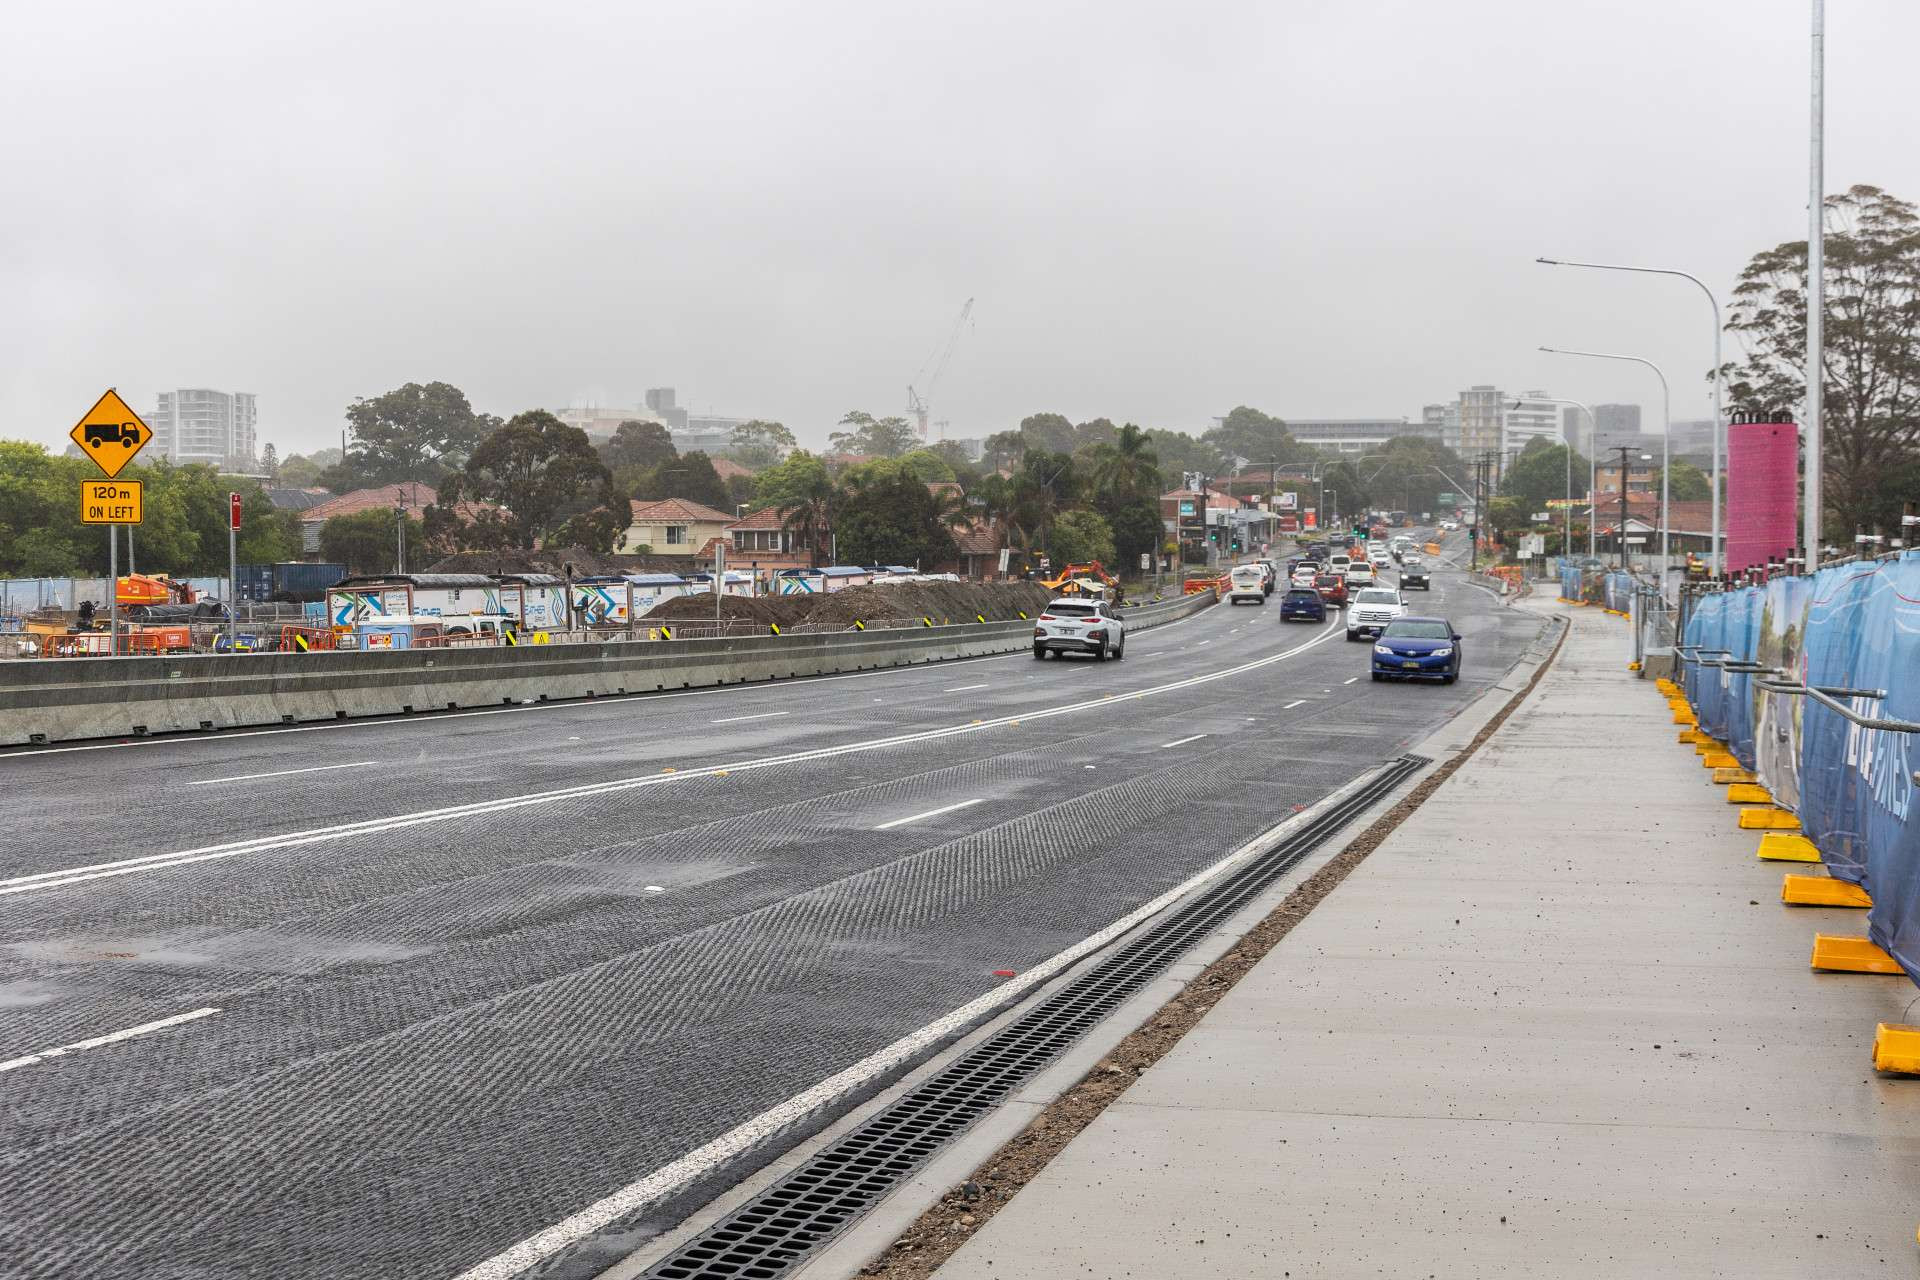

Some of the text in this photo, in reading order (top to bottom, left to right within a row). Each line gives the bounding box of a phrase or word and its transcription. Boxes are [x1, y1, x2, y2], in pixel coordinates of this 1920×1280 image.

[93, 486, 130, 499] 120 m
[89, 505, 134, 519] ON LEFT
